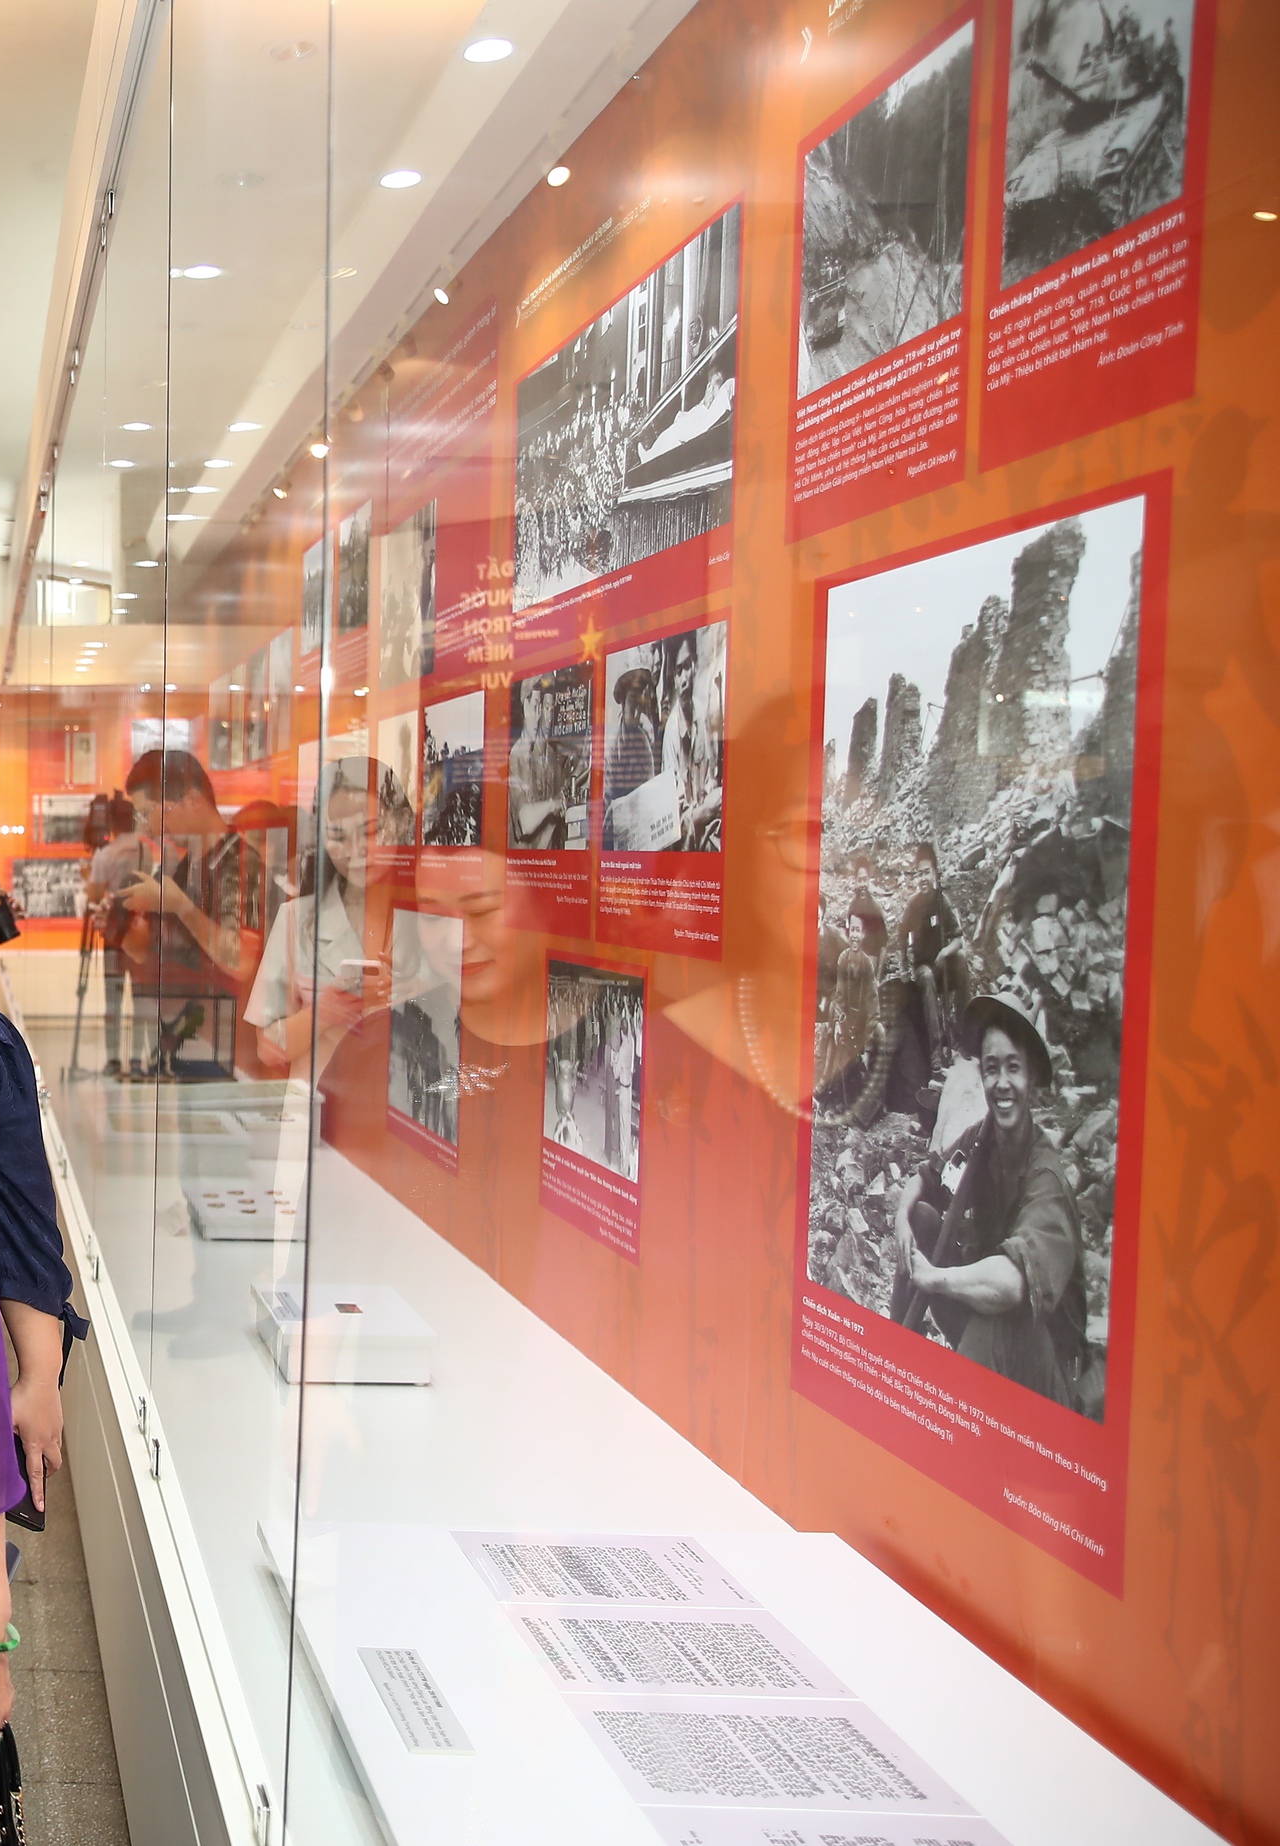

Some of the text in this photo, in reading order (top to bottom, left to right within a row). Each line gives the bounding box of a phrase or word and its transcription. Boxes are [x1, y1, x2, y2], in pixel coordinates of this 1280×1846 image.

[988, 345, 1004, 359] cuộc
[1007, 334, 1024, 350] hành
[1028, 325, 1046, 342] quân
[1050, 315, 1065, 330] Lam
[1069, 307, 1084, 321] Sơn
[1109, 284, 1130, 301] Cuộc
[1151, 258, 1186, 282] nghiệm
[989, 302, 1009, 320] Chiến
[1010, 292, 1032, 309] thắng
[1033, 278, 1059, 298] Đường
[1071, 262, 1090, 278] Nam
[1091, 254, 1109, 268] Lào,
[1113, 239, 1135, 257] ngày
[1136, 212, 1184, 246] 20/3/1971
[989, 331, 1001, 343] Sau
[1003, 323, 1012, 335] 45
[1014, 316, 1031, 331] ngày
[1033, 305, 1052, 324] phản
[1077, 283, 1098, 301] quân
[1101, 274, 1116, 288] dân
[1120, 268, 1129, 279] ta
[1131, 259, 1143, 274] đã
[1145, 246, 1168, 267] đánh
[1172, 239, 1187, 254] tan
[802, 1296, 864, 1335] Chiến dịch Xuân Hè 1972
[1003, 1487, 1104, 1556] Nguồn: Bảo tàng Hồ Chí Minh
